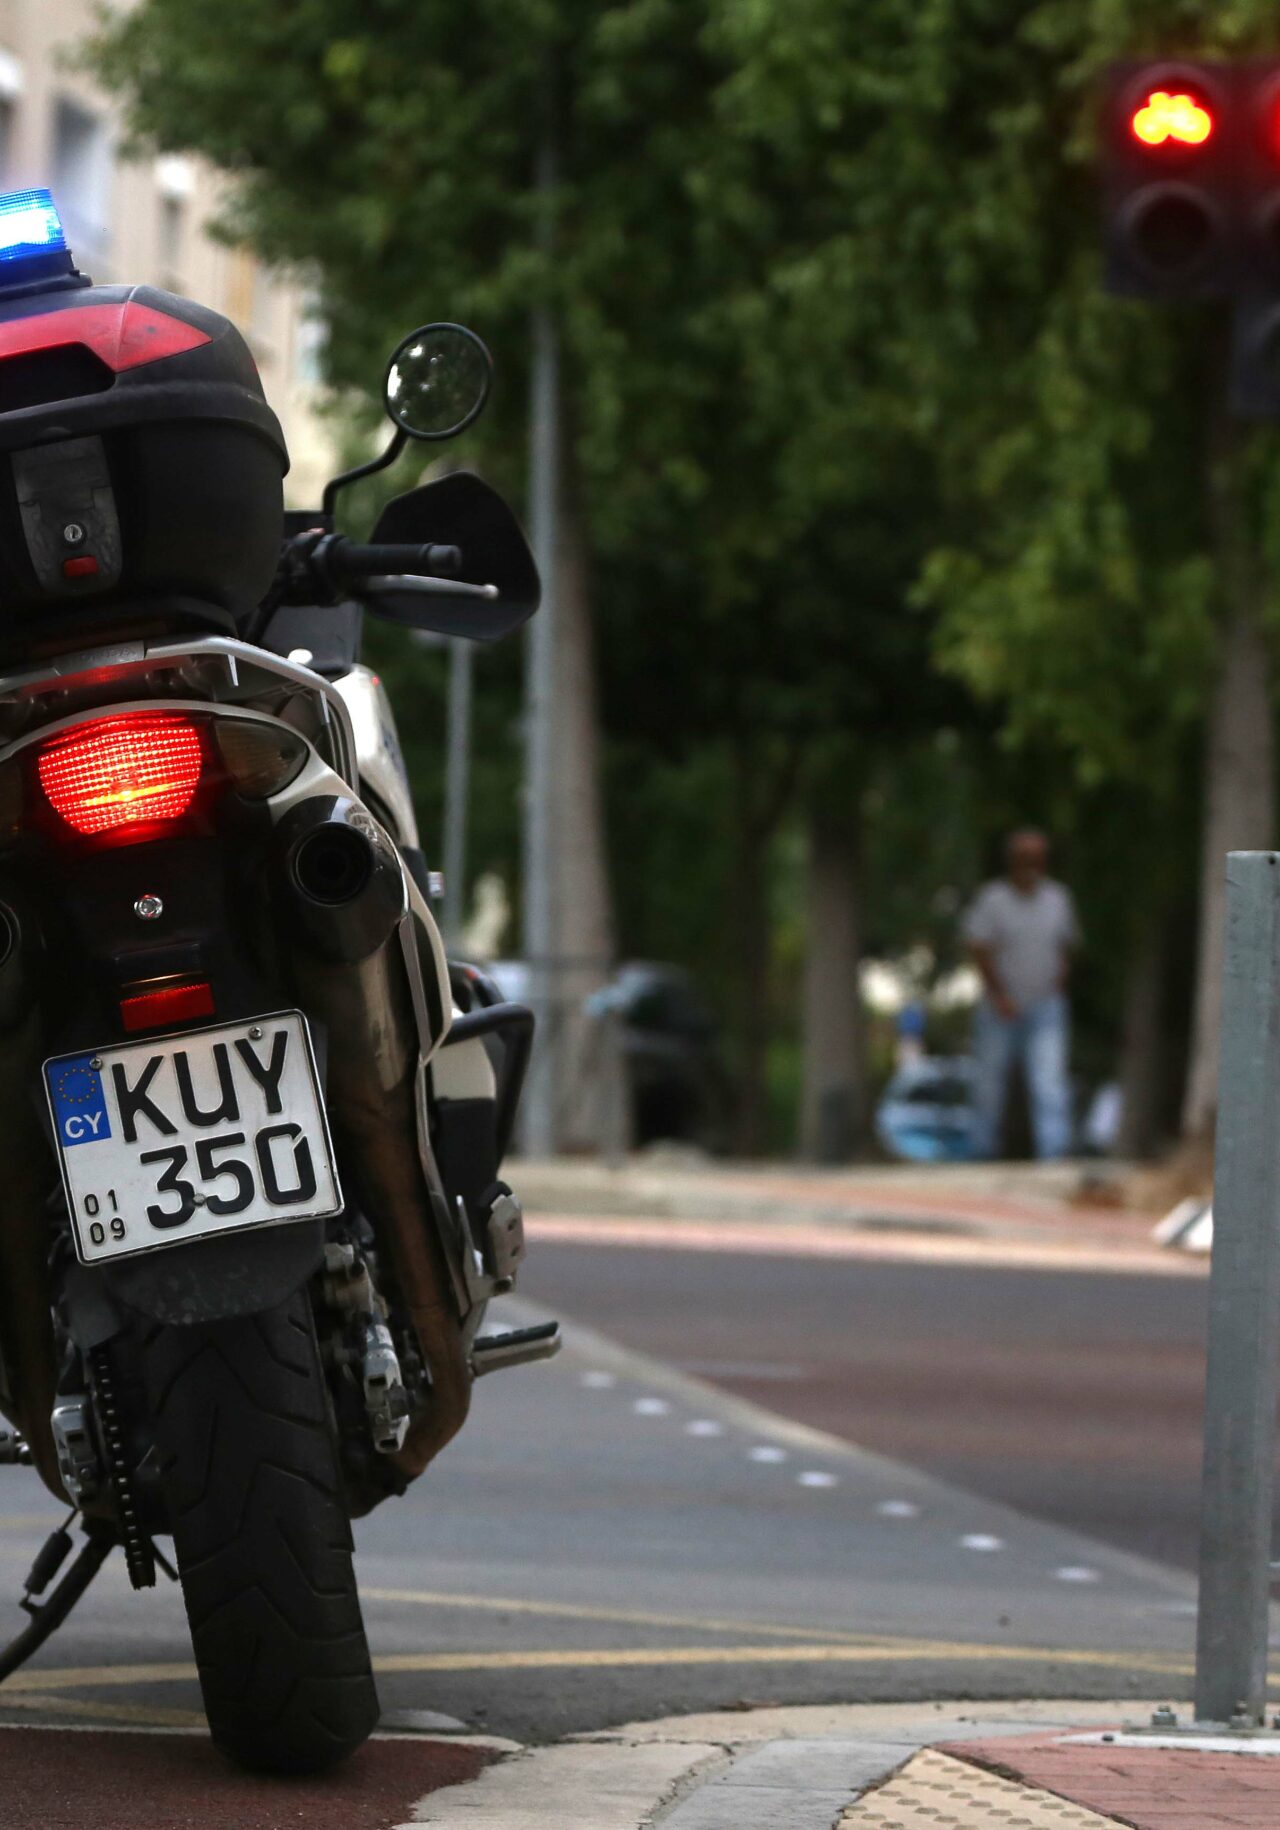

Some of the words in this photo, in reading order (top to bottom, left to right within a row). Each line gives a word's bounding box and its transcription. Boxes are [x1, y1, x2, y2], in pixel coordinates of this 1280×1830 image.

[111, 1030, 289, 1143] KUY
[64, 1111, 102, 1139] CY
[139, 1122, 318, 1230] 350
[83, 1189, 119, 1216] 01
[89, 1217, 126, 1245] 09
